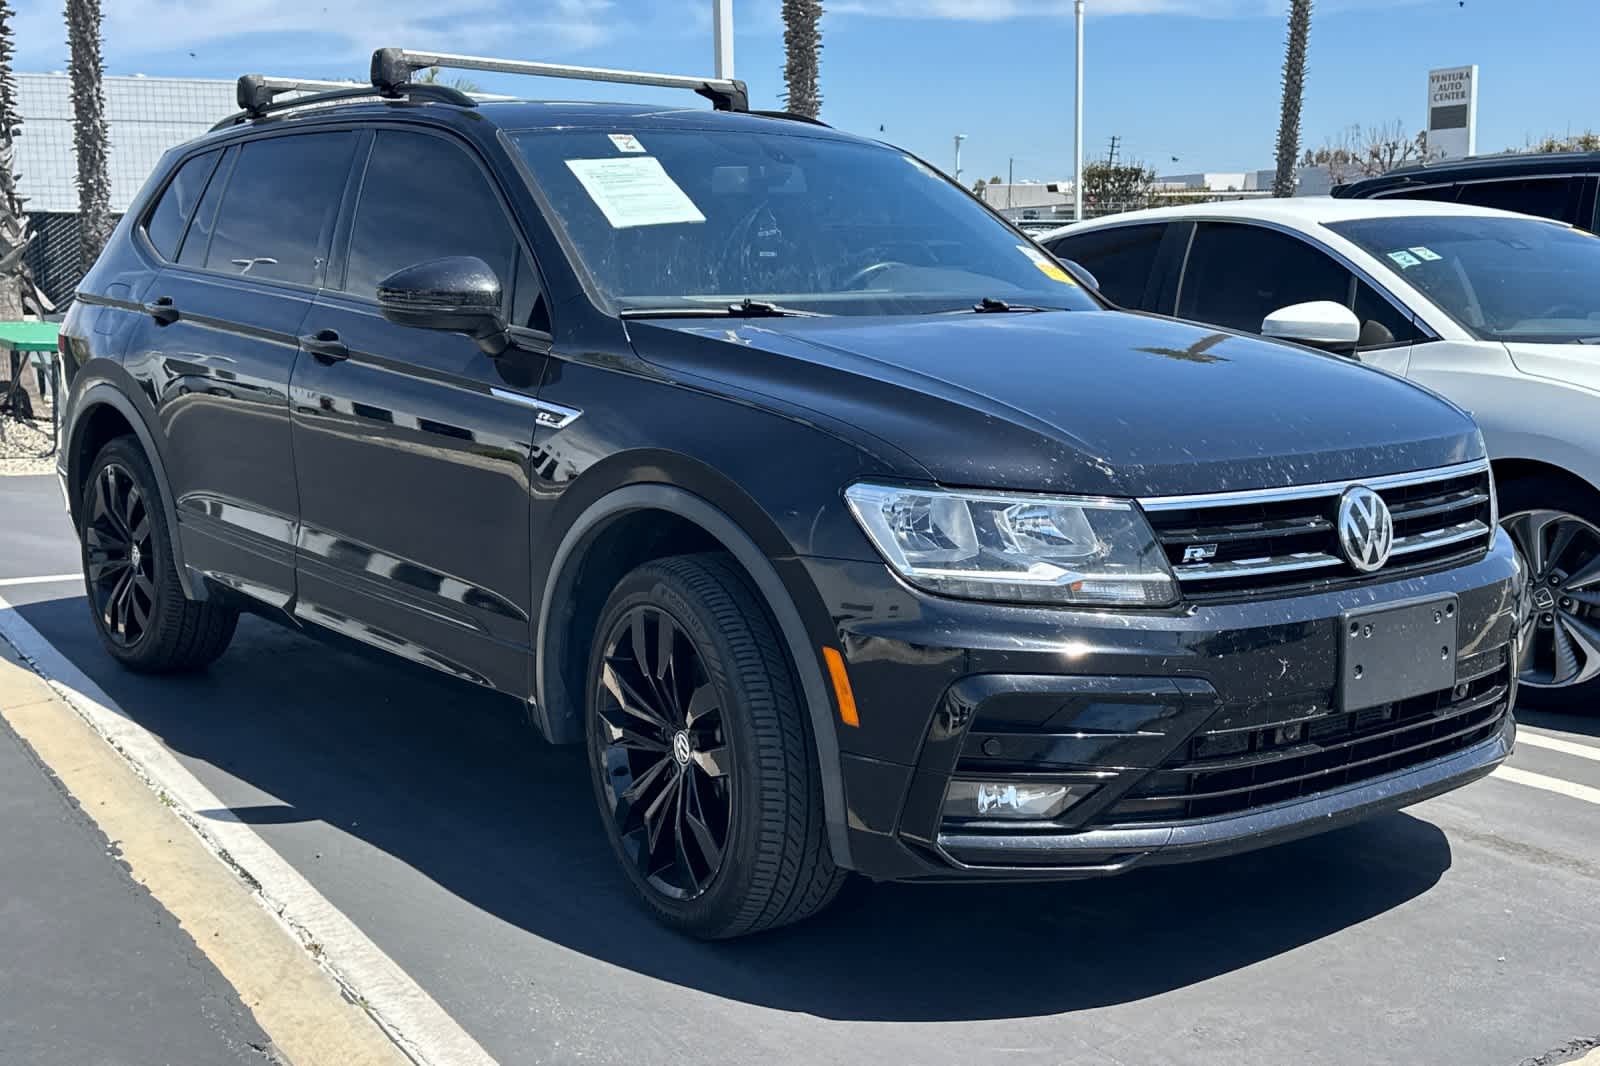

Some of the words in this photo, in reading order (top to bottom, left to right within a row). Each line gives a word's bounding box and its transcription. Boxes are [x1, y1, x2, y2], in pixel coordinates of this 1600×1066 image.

[1431, 72, 1470, 83] VENTURA
[1438, 82, 1462, 91] AUTO
[1433, 91, 1466, 101] CENTER
